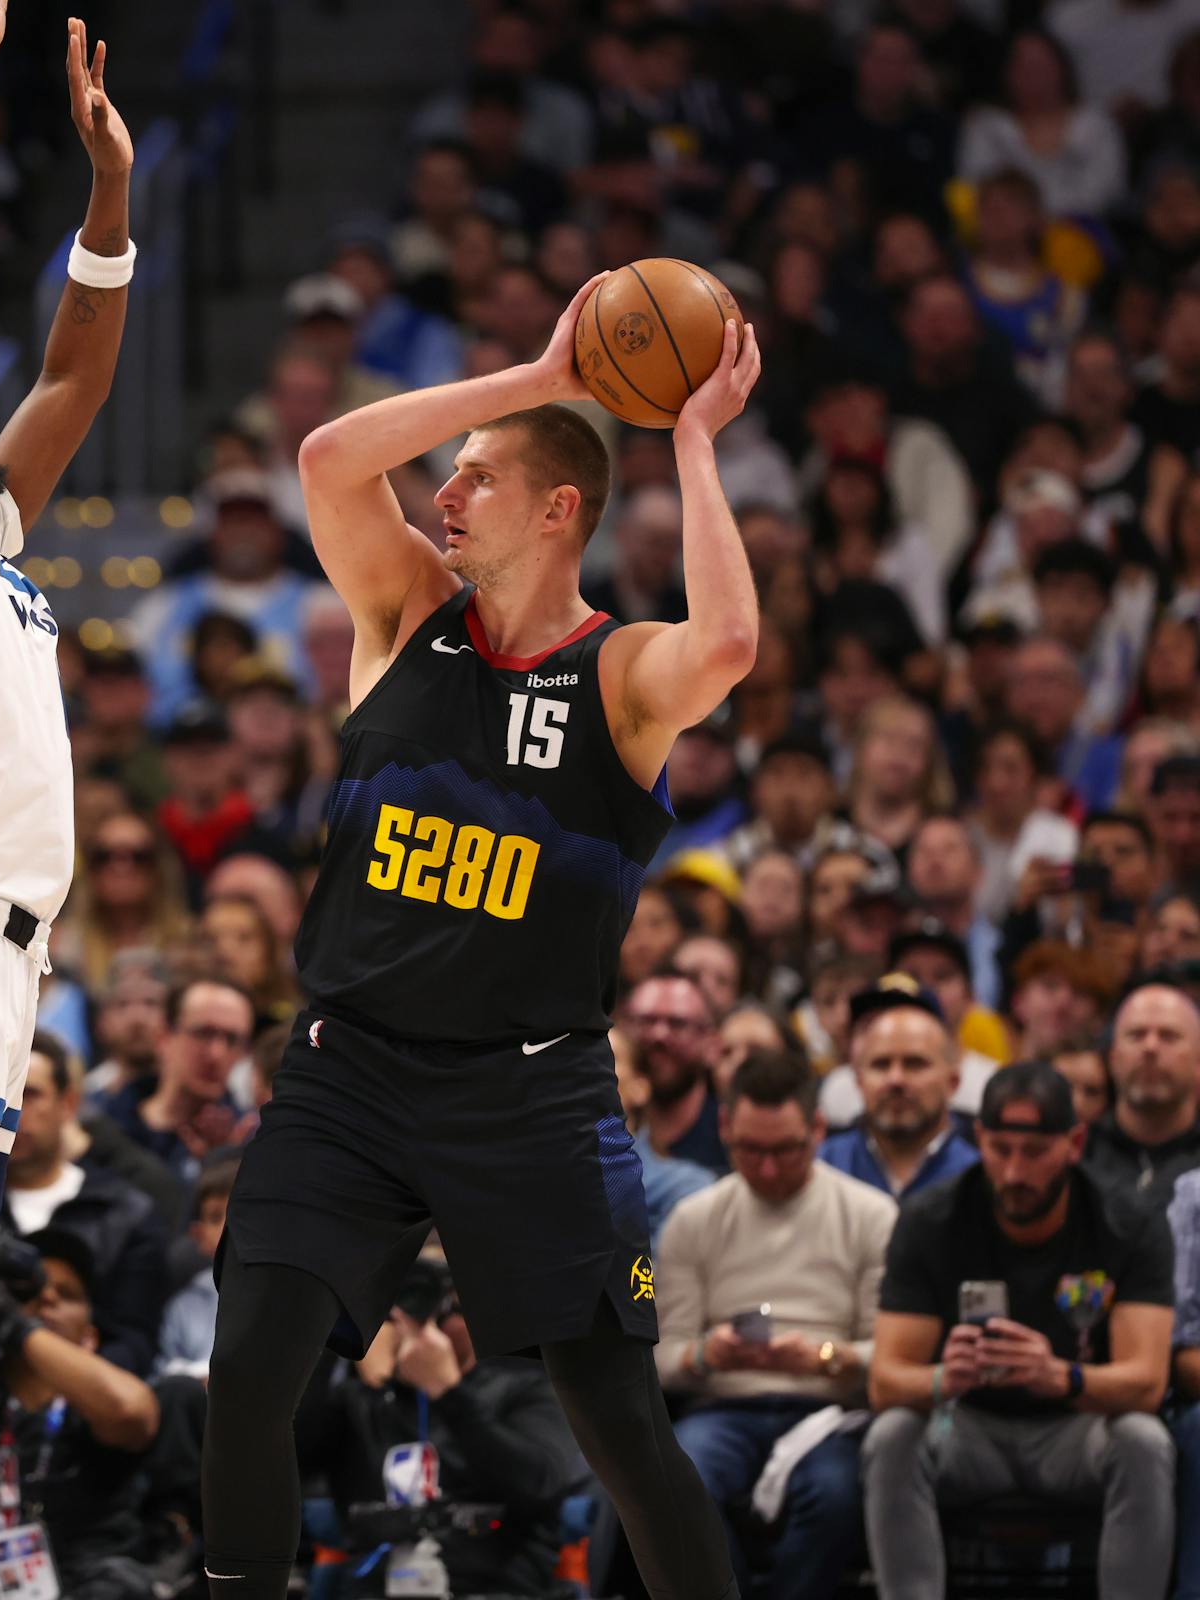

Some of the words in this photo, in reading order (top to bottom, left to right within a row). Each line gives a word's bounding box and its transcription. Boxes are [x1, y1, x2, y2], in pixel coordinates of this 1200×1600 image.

[527, 673, 579, 689] ibotta
[506, 692, 570, 770] 15
[367, 803, 540, 920] 5280
